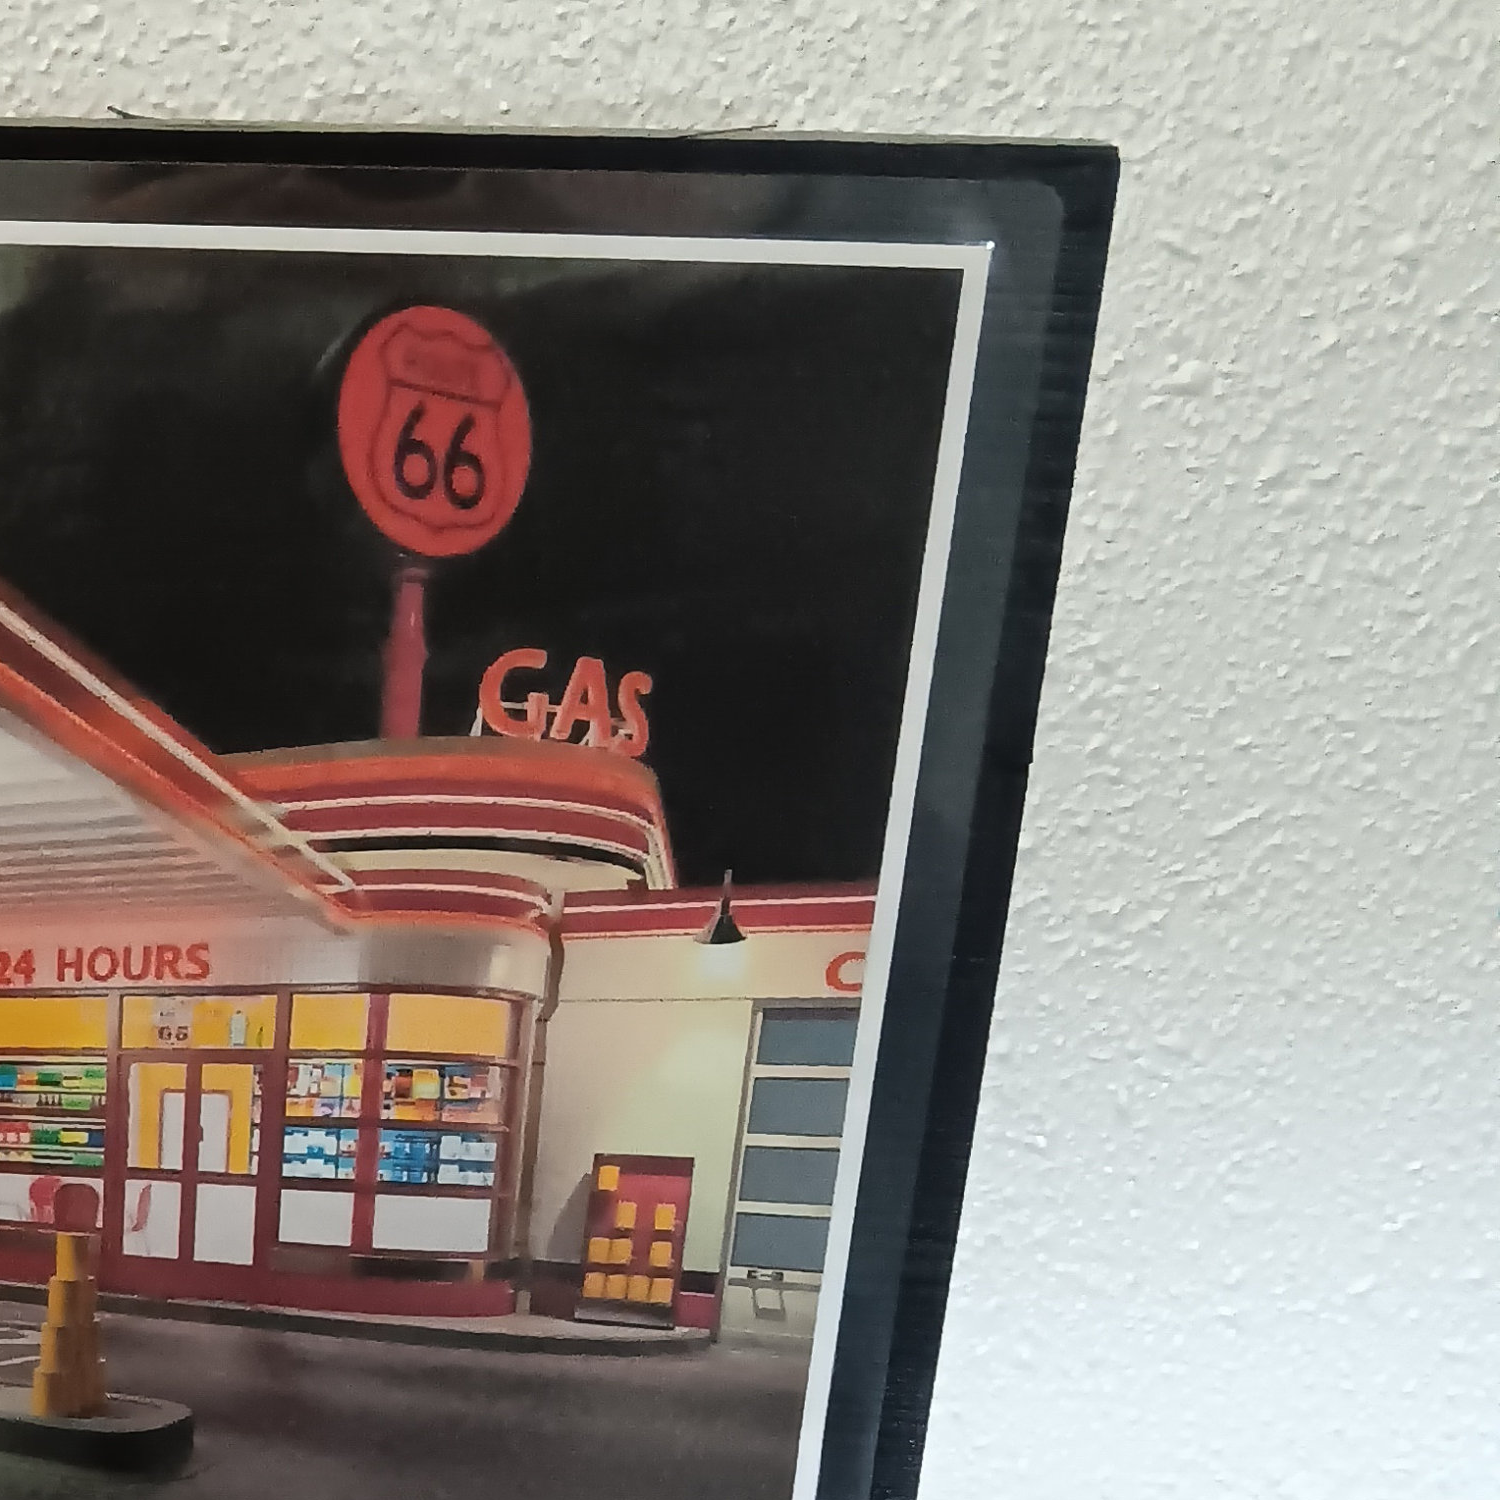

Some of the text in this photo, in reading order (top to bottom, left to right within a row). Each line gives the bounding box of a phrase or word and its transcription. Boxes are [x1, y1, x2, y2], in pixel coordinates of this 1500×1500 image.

[395, 401, 485, 510] 66
[479, 647, 653, 758] GAS
[56, 943, 211, 983] HOURS
